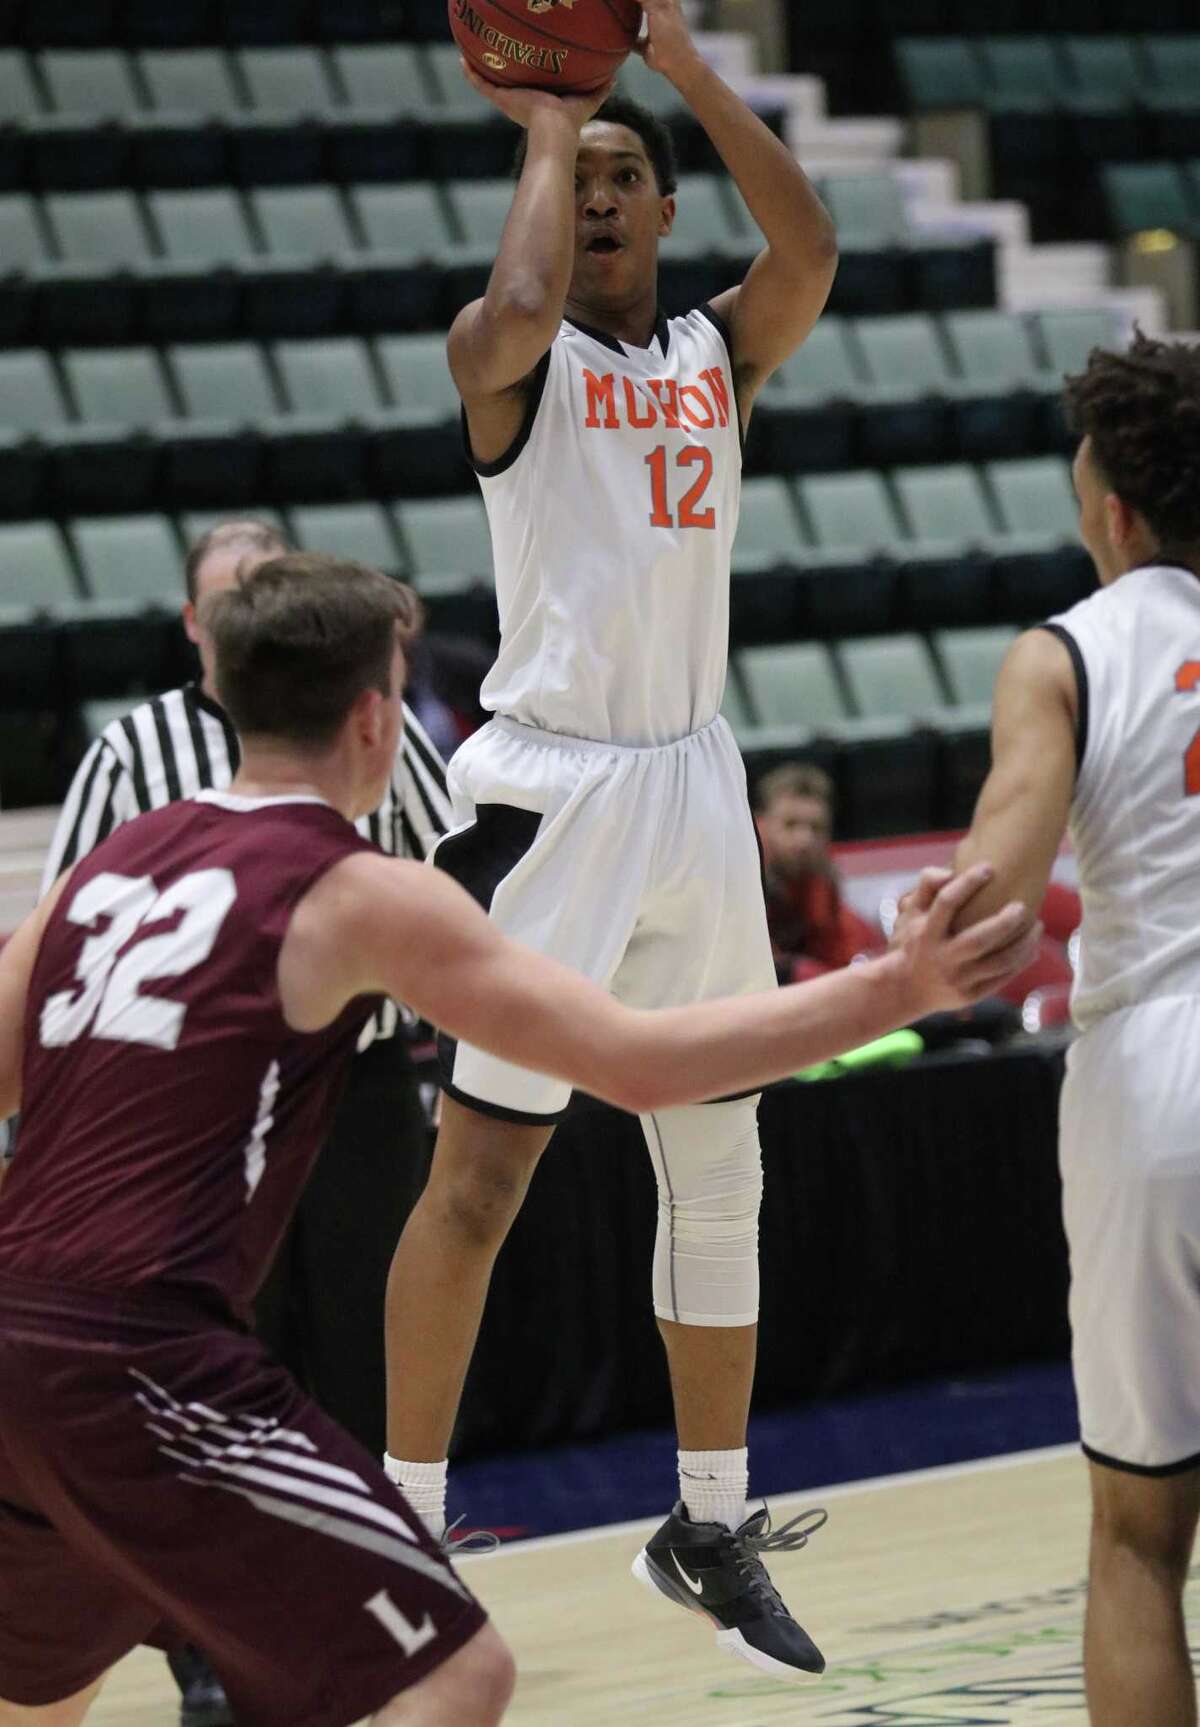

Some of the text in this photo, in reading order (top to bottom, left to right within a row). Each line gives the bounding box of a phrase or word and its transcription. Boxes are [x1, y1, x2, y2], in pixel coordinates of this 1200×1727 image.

[644, 445, 716, 529] 12
[39, 867, 238, 1050] 32
[363, 1587, 438, 1658] L
